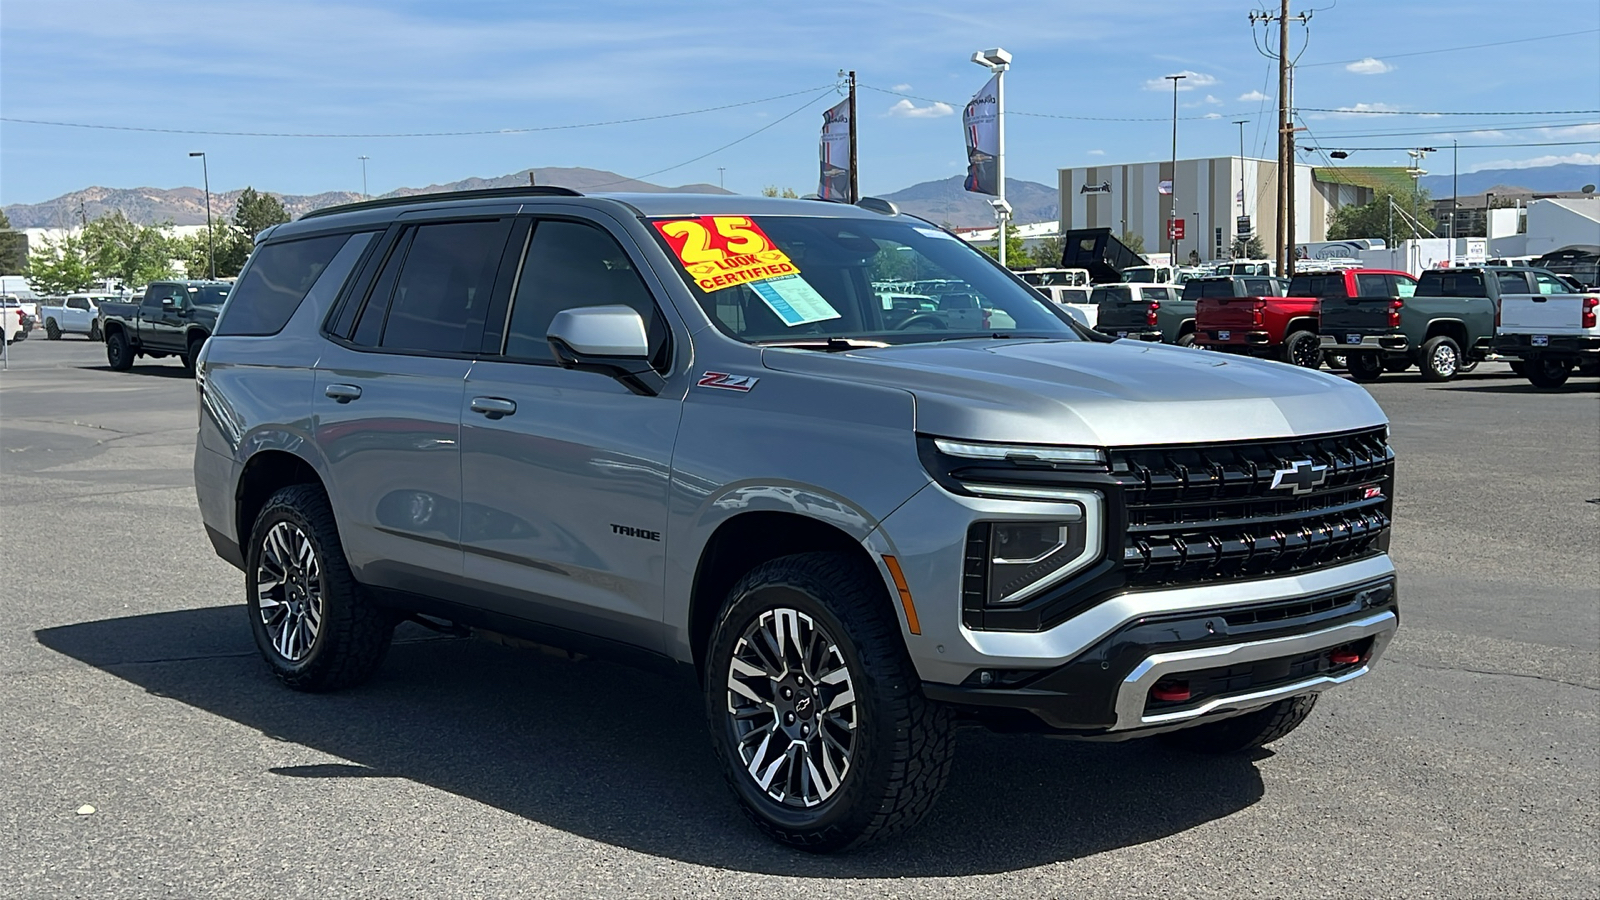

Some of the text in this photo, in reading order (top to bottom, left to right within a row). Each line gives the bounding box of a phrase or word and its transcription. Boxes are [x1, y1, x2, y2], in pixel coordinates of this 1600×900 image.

[661, 216, 769, 264] 25
[715, 254, 763, 271] LOOK
[699, 263, 793, 289] CERTIFIED
[696, 371, 760, 393] Z71
[610, 523, 661, 542] TAHOE
